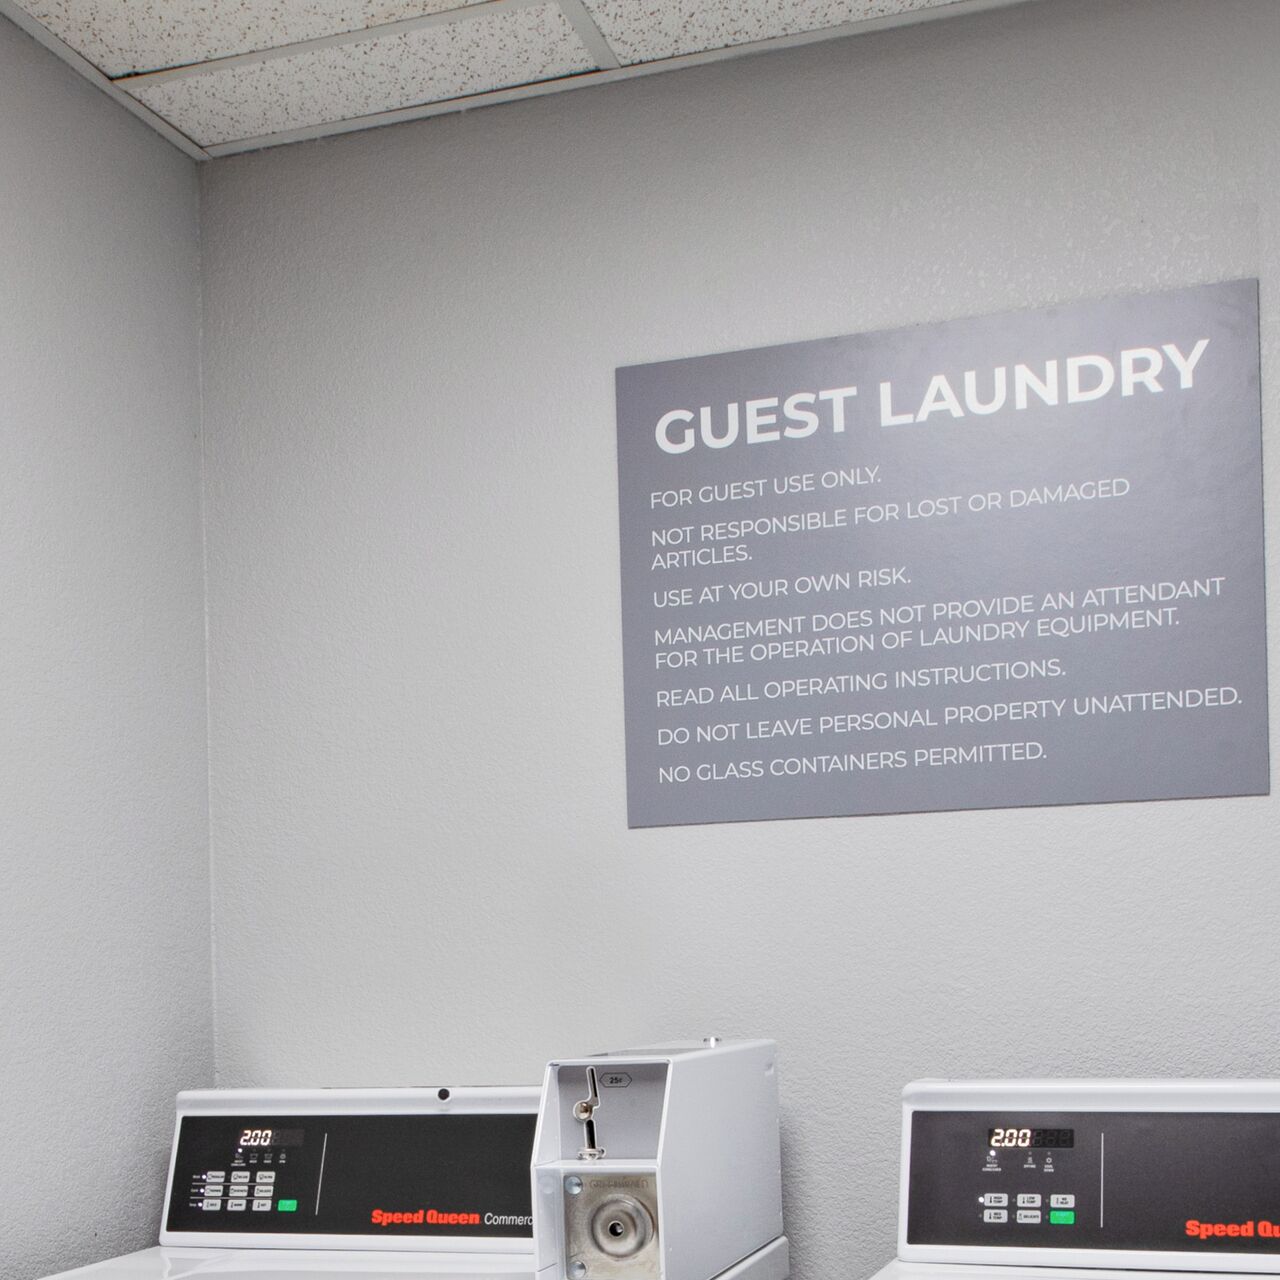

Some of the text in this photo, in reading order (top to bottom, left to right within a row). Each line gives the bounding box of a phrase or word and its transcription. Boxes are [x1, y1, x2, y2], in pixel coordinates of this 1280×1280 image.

[655, 339, 1210, 454] GUEST LAUNDRY
[651, 465, 881, 509] FOR GUEST USE ONLY.
[652, 478, 1130, 547] NOT RESPONSIBLE FOR LOST OR DAMAGED
[651, 544, 752, 570] ARTICLES.
[654, 567, 911, 608] USE AT YOUR OWN RISK.
[655, 577, 1225, 646] MANAGEMENT DOES NOT PROVIDE AN ATTENDANT
[656, 607, 1179, 669] FOR THE OPERATION OF LAUNDRY EQUIPMENT.
[657, 658, 1066, 707] READ ALL OPERATING INSTRUCTIONS.
[658, 687, 1242, 745] DO NOT LEAVE PERSONAL PROPERTY UNATTENDED.
[659, 742, 1047, 783] NO GLASS CONTAINERS PERMITTED.
[239, 1129, 272, 1146] 2.00
[990, 1128, 1032, 1147] 2.00
[371, 1208, 534, 1226] Speed Queen Commerc
[1186, 1220, 1254, 1239] Speed
